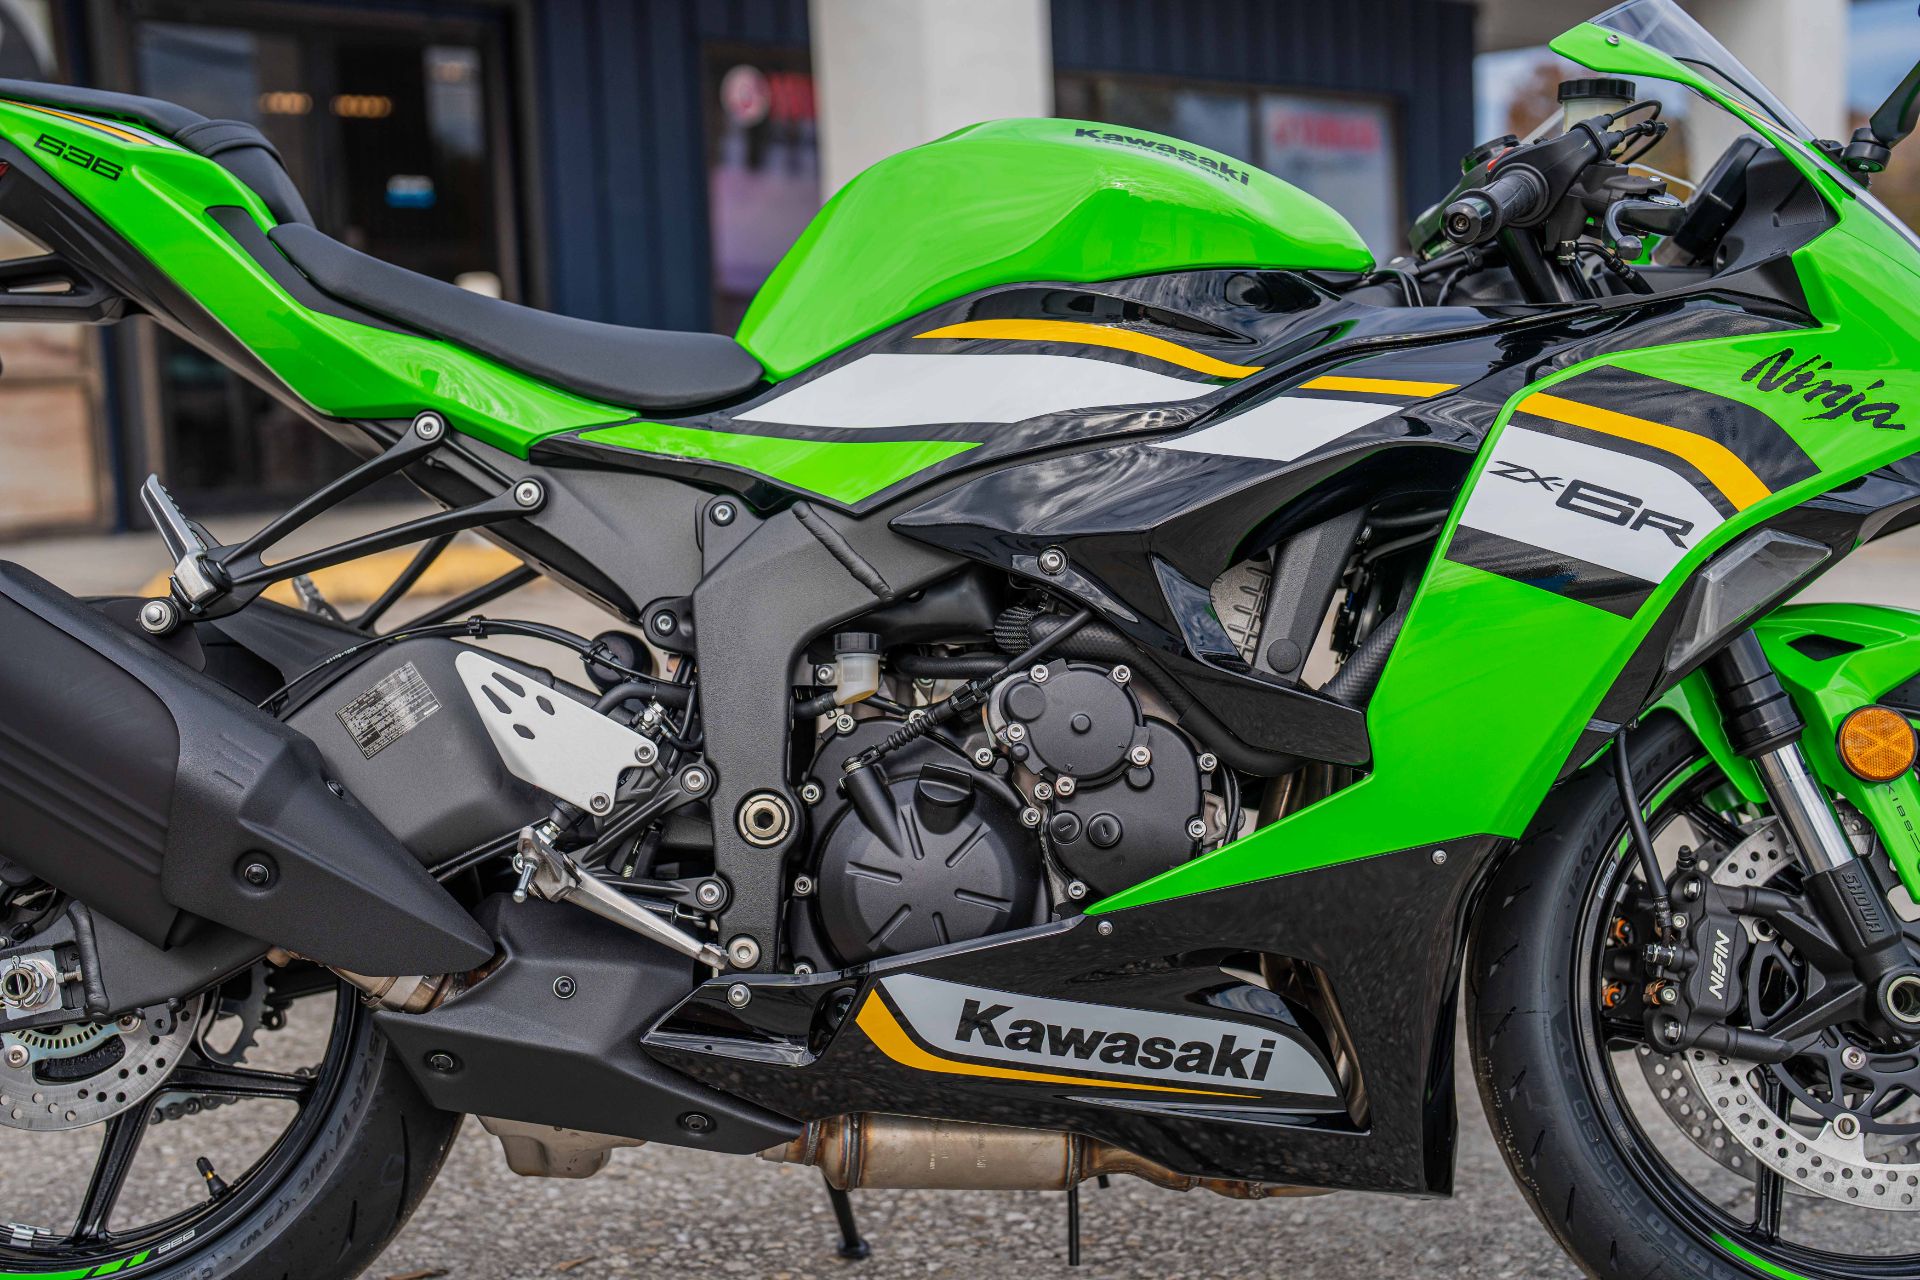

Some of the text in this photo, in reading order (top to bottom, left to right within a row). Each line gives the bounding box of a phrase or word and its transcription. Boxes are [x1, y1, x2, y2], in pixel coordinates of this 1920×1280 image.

[34, 133, 124, 181] 636
[1075, 128, 1250, 186] Kawasaki
[1741, 348, 1906, 430] Ninja
[1487, 460, 1695, 550] ZX-6R
[1841, 872, 1885, 933] SHOWA
[1709, 929, 1730, 1000] NISSIN
[955, 998, 1277, 1082] Kawasaki
